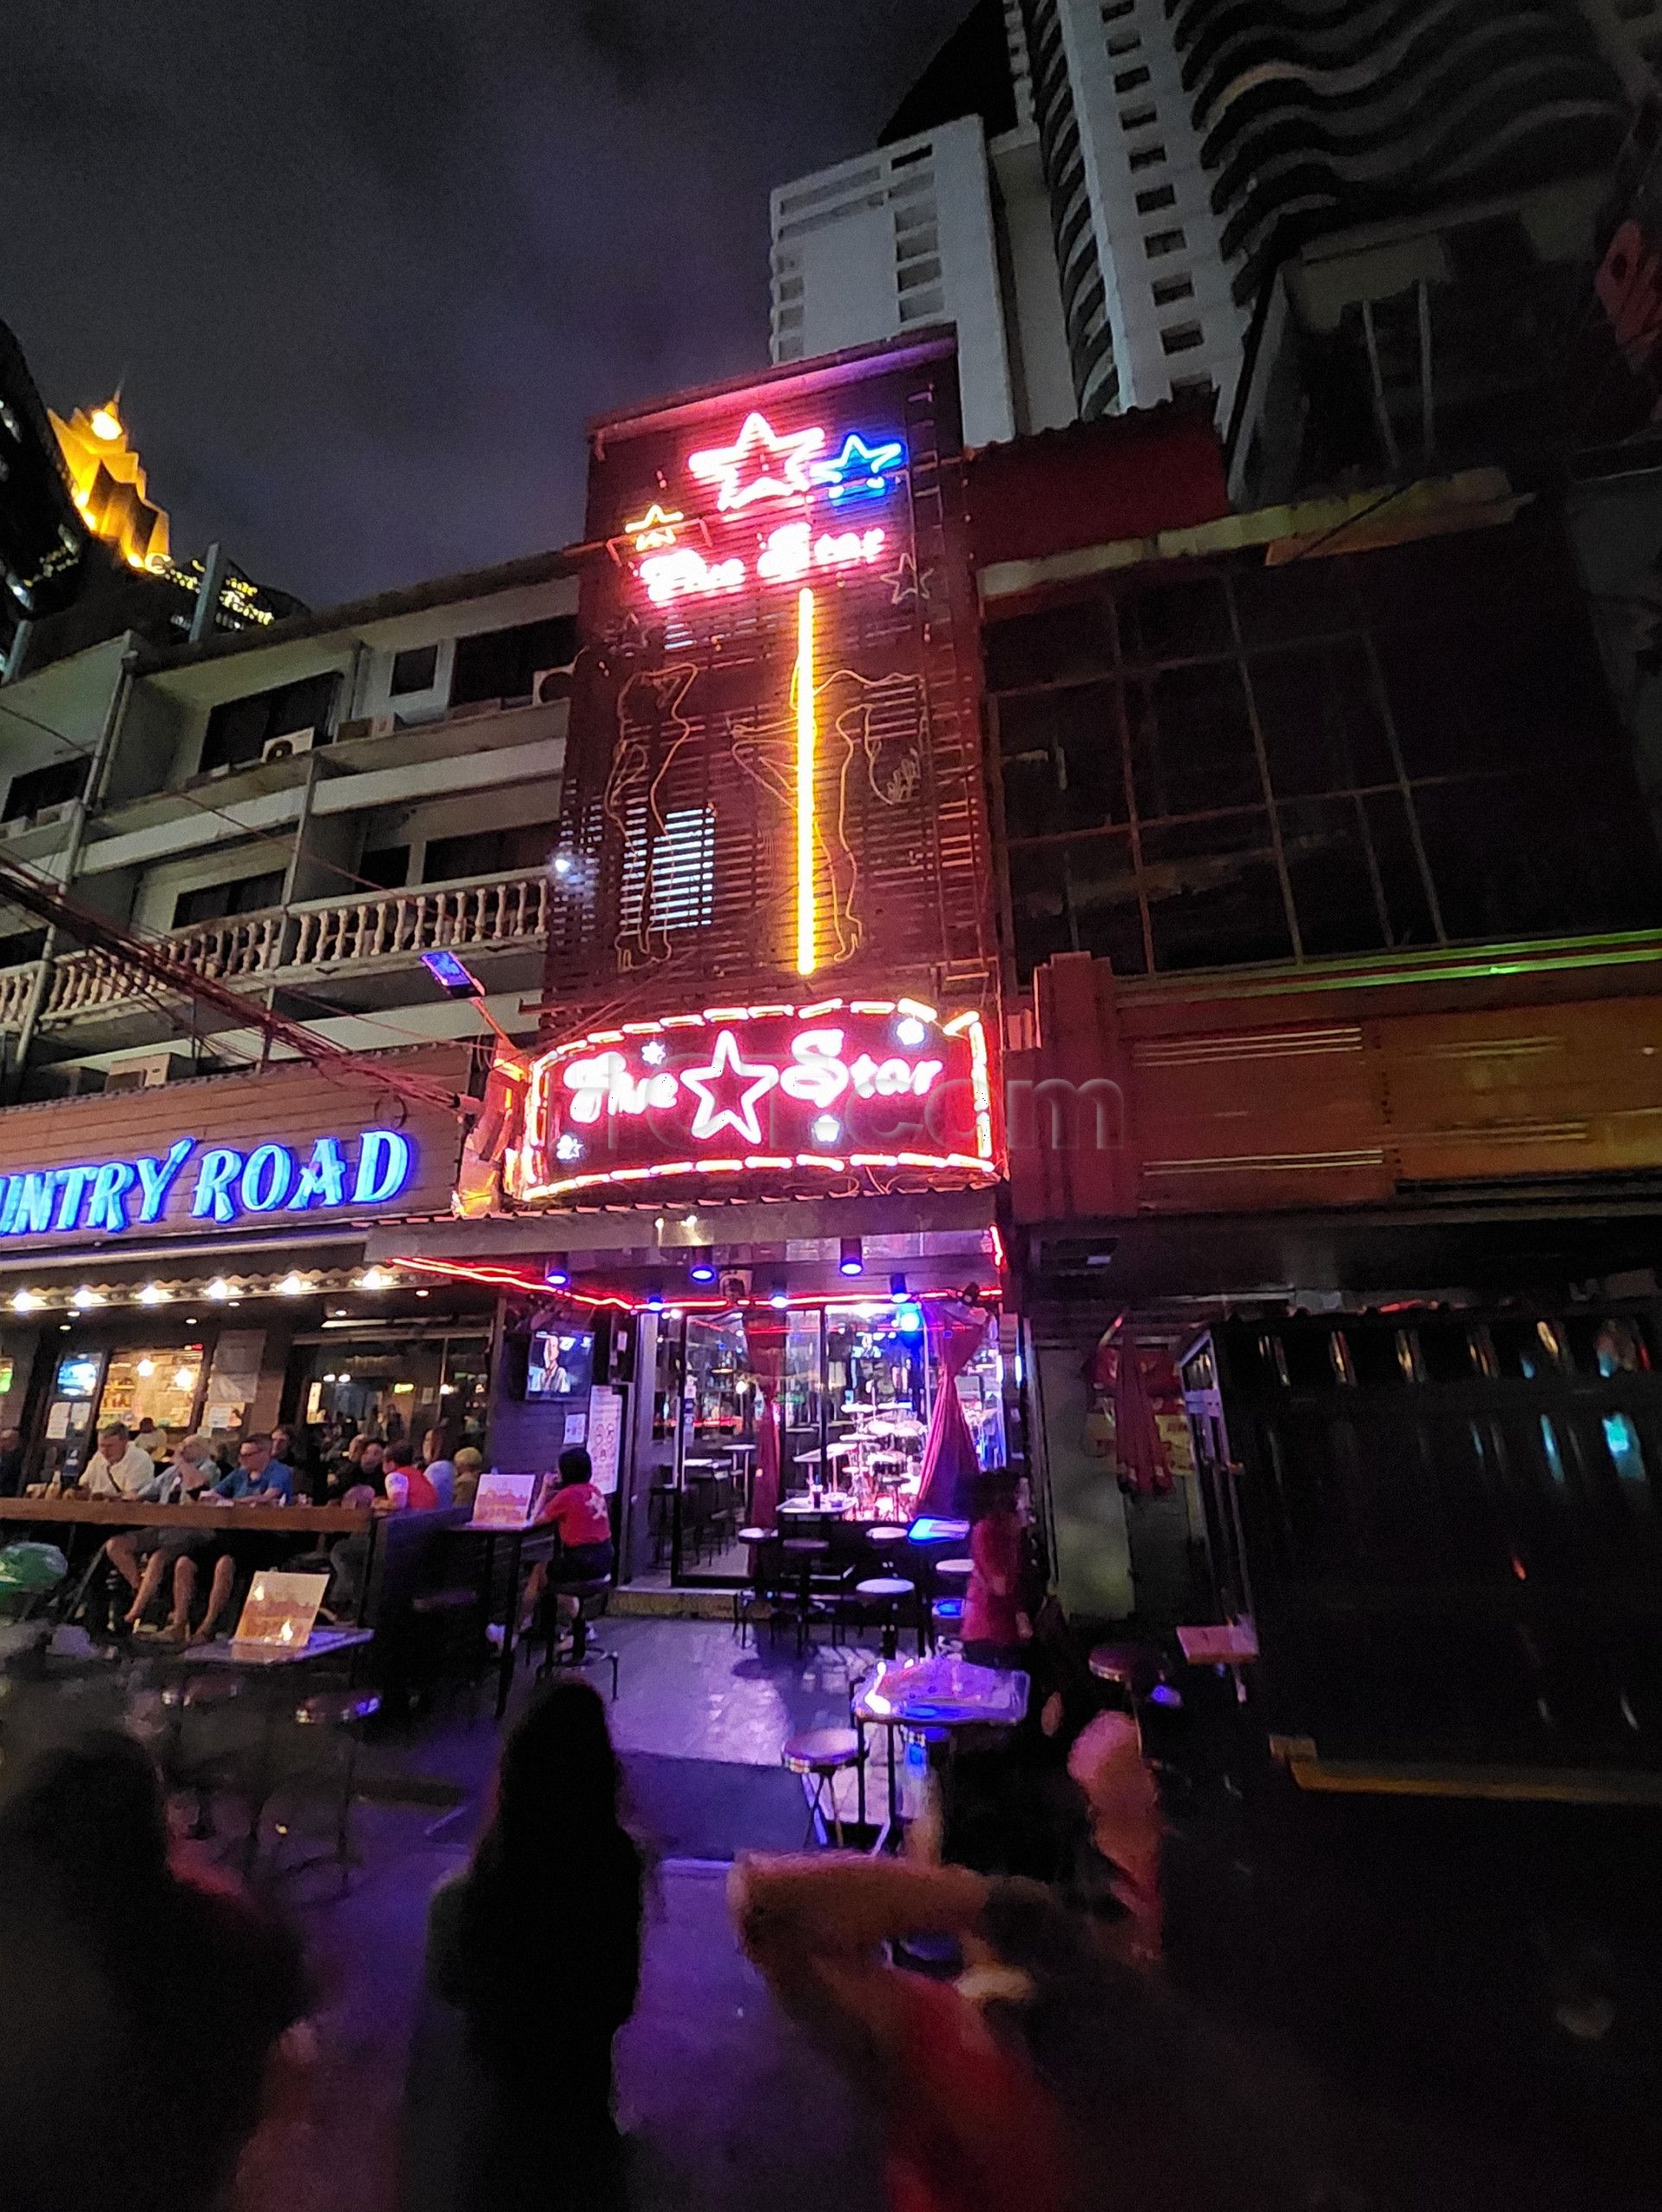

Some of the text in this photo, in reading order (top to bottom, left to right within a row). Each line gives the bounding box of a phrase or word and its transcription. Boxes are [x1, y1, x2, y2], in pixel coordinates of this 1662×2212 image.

[563, 1027, 944, 1123] The Star
[191, 1129, 410, 1224] ROAD
